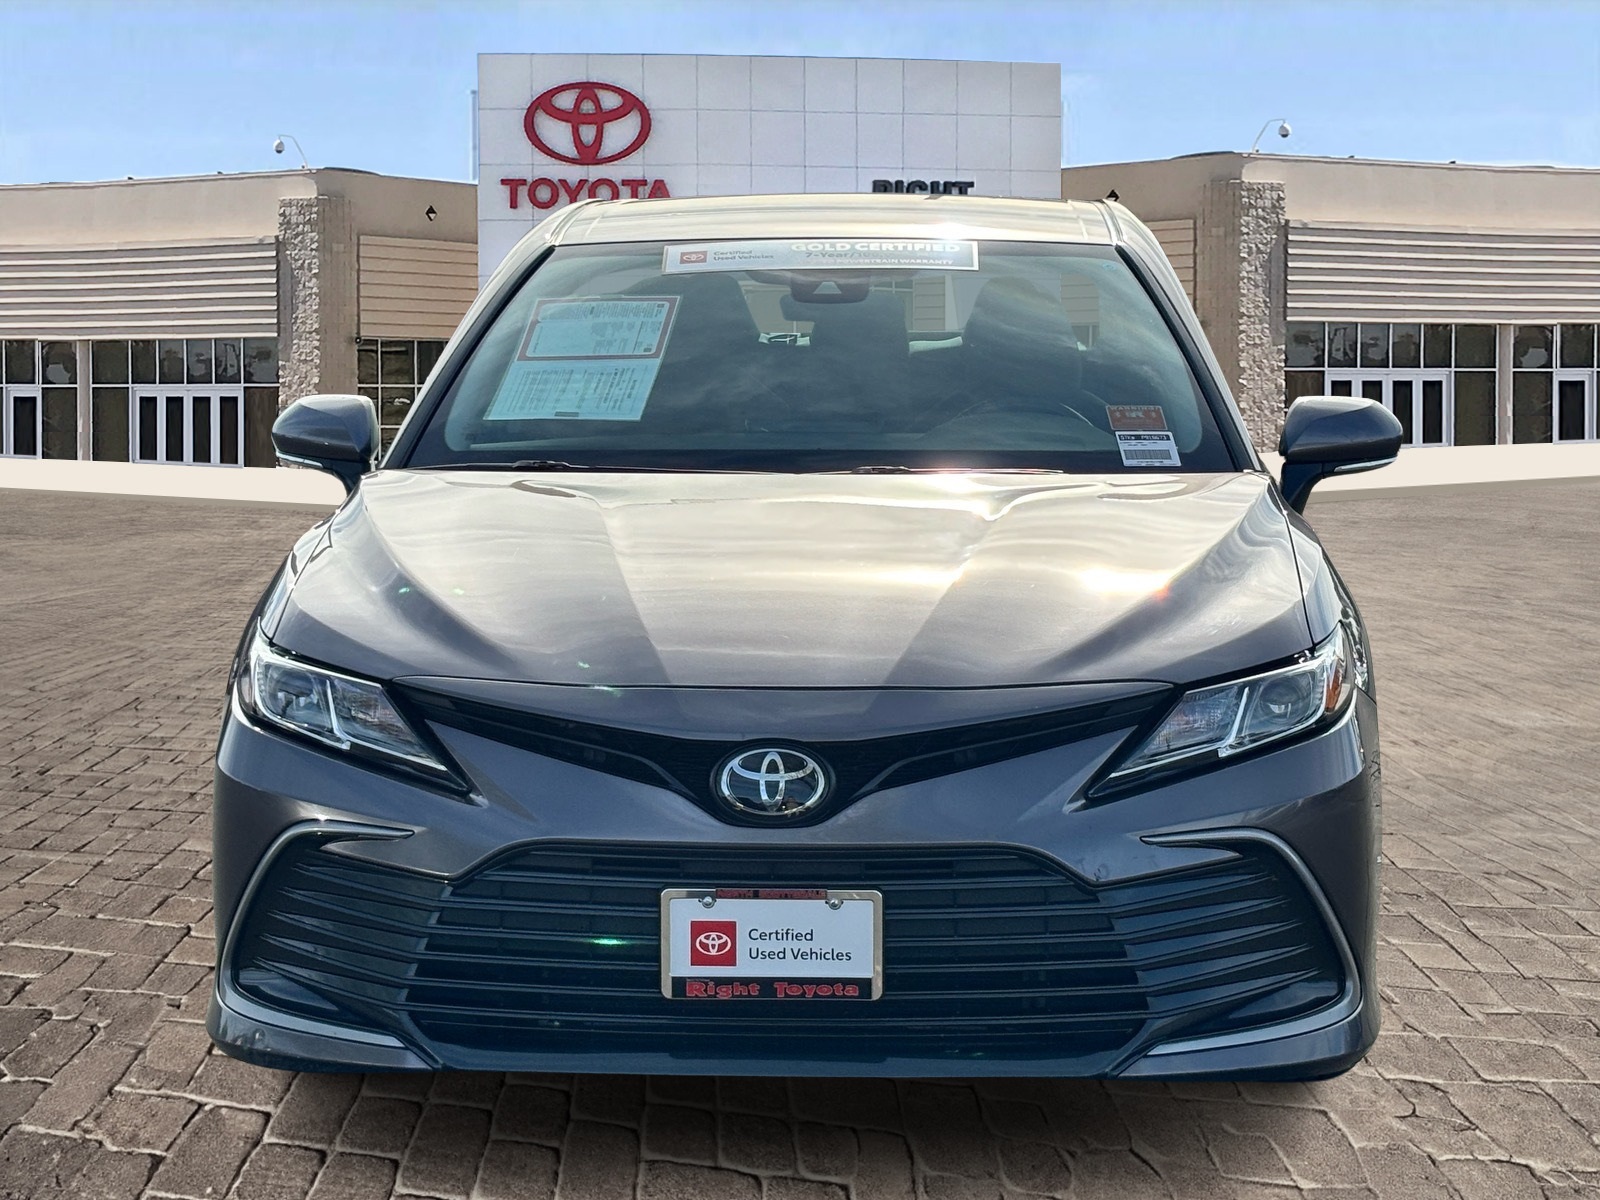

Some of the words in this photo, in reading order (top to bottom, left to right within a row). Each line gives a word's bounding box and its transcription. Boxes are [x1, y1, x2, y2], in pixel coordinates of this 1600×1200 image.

[500, 178, 671, 209] TOYOTA
[791, 242, 851, 251] GOLD
[854, 242, 960, 252] CERTIFIED
[748, 928, 814, 942] Certified
[749, 947, 786, 960] Used
[791, 947, 852, 961] Vehicles
[686, 981, 760, 998] Right
[774, 981, 859, 997] Toyota
